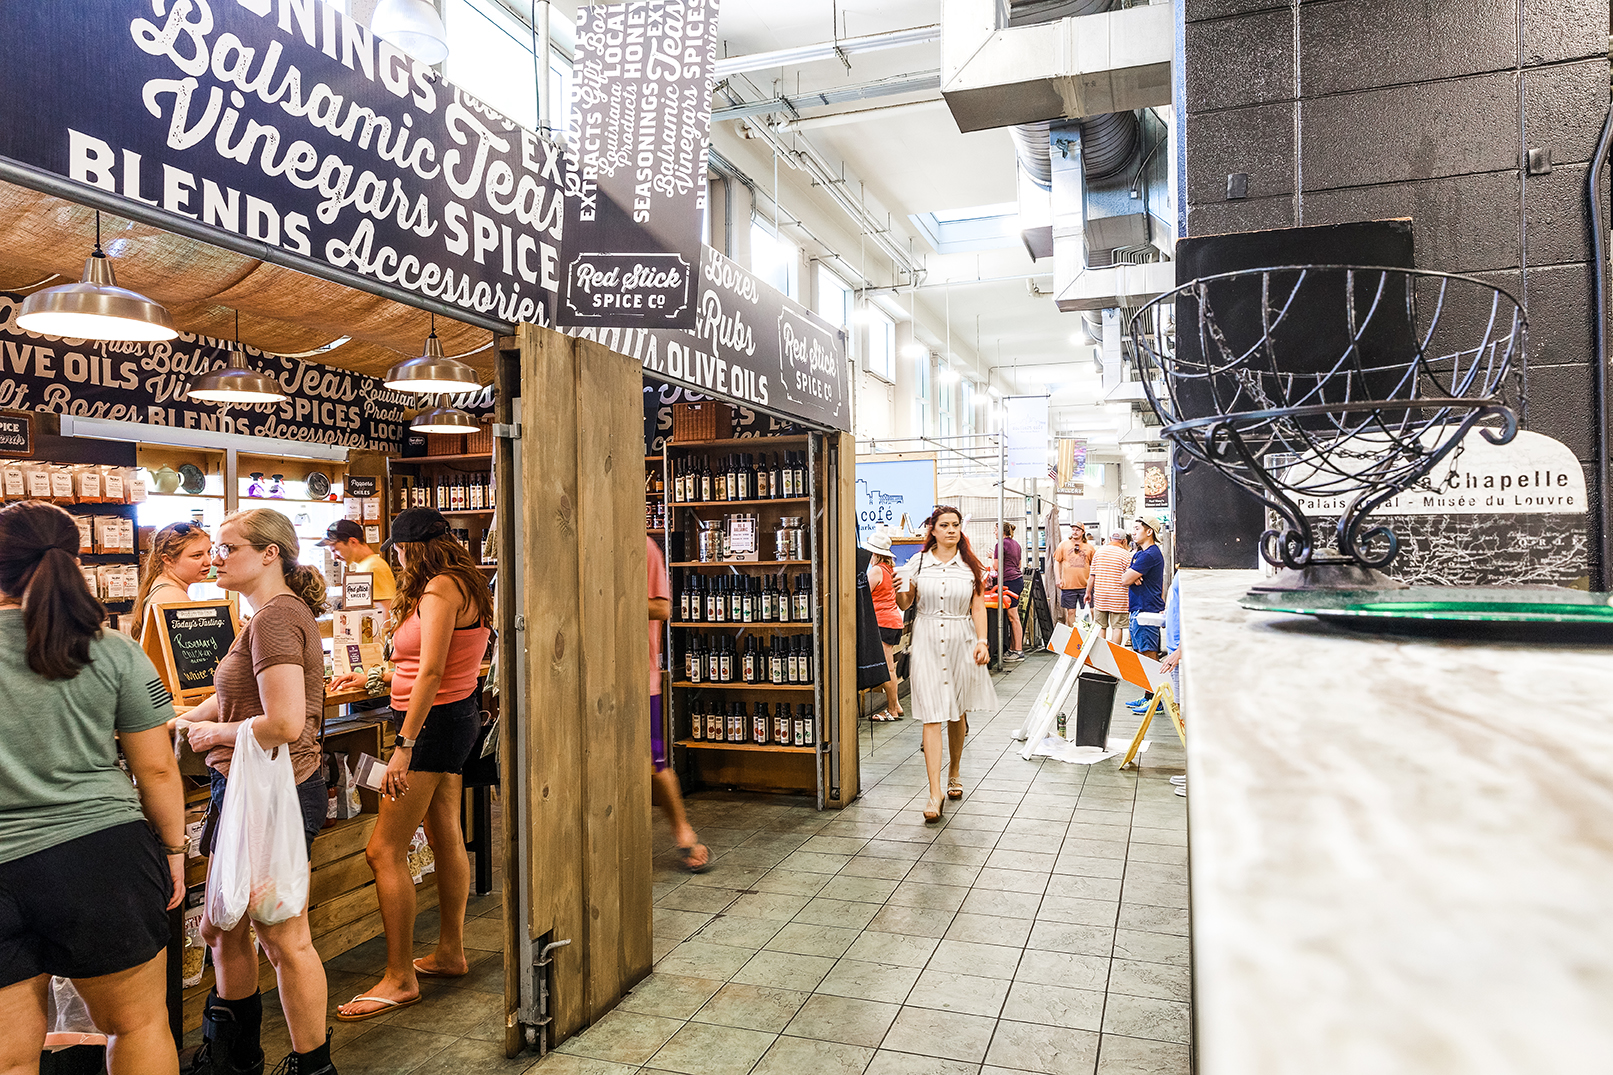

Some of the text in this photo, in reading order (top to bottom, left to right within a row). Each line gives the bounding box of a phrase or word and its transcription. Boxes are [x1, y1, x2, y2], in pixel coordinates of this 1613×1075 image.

[604, 3, 626, 77] LOCAL
[624, 2, 646, 79] HONEY
[646, 0, 685, 82] Teas
[130, 0, 440, 179] Balsamic
[581, 59, 609, 109] Gift
[142, 77, 438, 237] Vinegars
[599, 82, 622, 178] Louisiana
[617, 82, 637, 168] Products
[633, 82, 659, 223] SEASONINGS
[653, 83, 679, 198] Balsamic
[674, 85, 701, 195] Vinegars
[68, 128, 311, 257] BLENDS
[443, 102, 564, 241] Teas
[580, 112, 602, 222] EXTRACTS
[325, 218, 549, 328] Accessories
[577, 263, 682, 294] Red Stick
[592, 293, 643, 309] SPICE
[704, 249, 759, 304] Boxes
[702, 289, 755, 361] Rubs
[783, 322, 836, 378] Red Stick
[35, 384, 143, 424] Boxes
[63, 352, 139, 391] OILS
[278, 358, 359, 401] Teas
[668, 341, 728, 391] OLIVE
[731, 365, 769, 406] OILS
[796, 371, 823, 399] SPICE
[147, 405, 250, 436] BLENDS
[254, 414, 368, 448] Accessories
[279, 397, 361, 429] SPICES
[1298, 499, 1346, 508] Palais
[1423, 496, 1477, 507] Musée
[1486, 495, 1504, 507] du
[1515, 495, 1575, 506] Louvre
[1448, 471, 1568, 491] Chapelle
[171, 619, 198, 630] Today's
